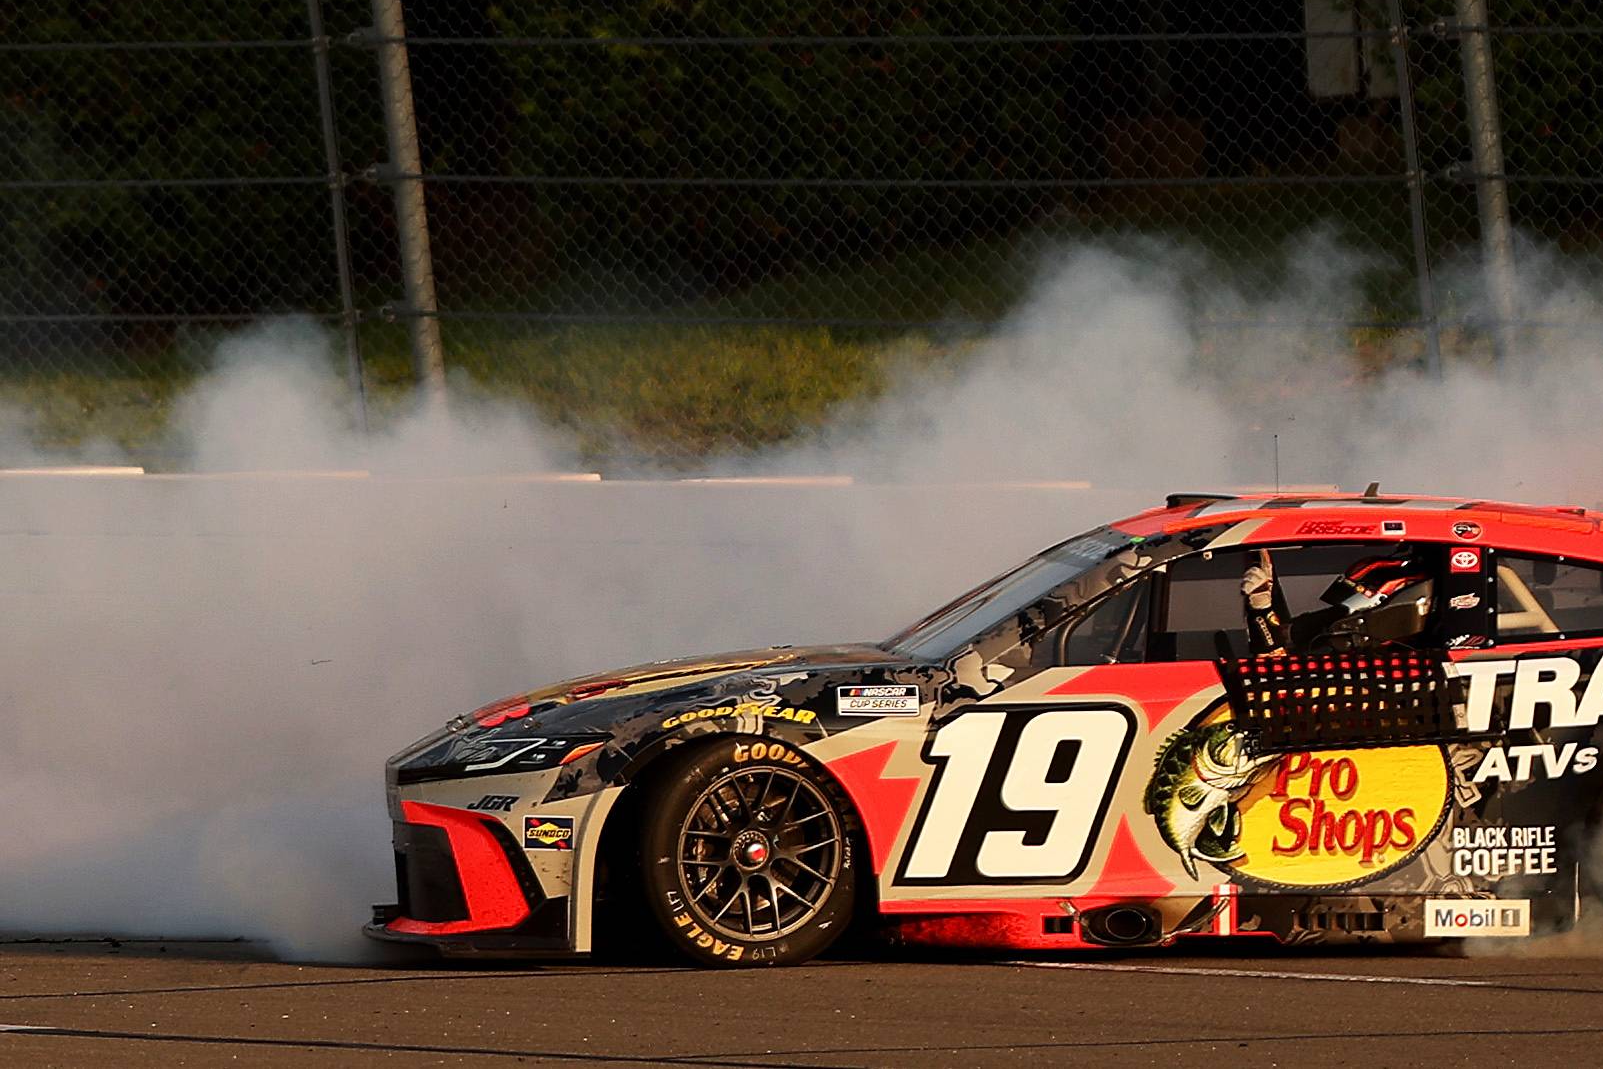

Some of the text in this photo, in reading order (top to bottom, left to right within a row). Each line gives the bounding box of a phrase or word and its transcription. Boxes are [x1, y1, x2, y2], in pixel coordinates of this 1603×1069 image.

[849, 698, 908, 709] CUP SERIES
[862, 687, 906, 697] NASCAR
[662, 703, 817, 729] GOODYEAR
[1269, 751, 1358, 800] Pro
[1472, 742, 1599, 783] ATVs
[466, 794, 520, 812] JGR
[904, 710, 1129, 878] 19
[528, 828, 571, 838] SUNOCO
[1271, 797, 1417, 867] Shops
[1453, 826, 1556, 849] BLACK RIFLE
[1454, 847, 1557, 876] COFFEE
[1435, 908, 1495, 928] Mobil
[674, 911, 745, 961] EAGLE
